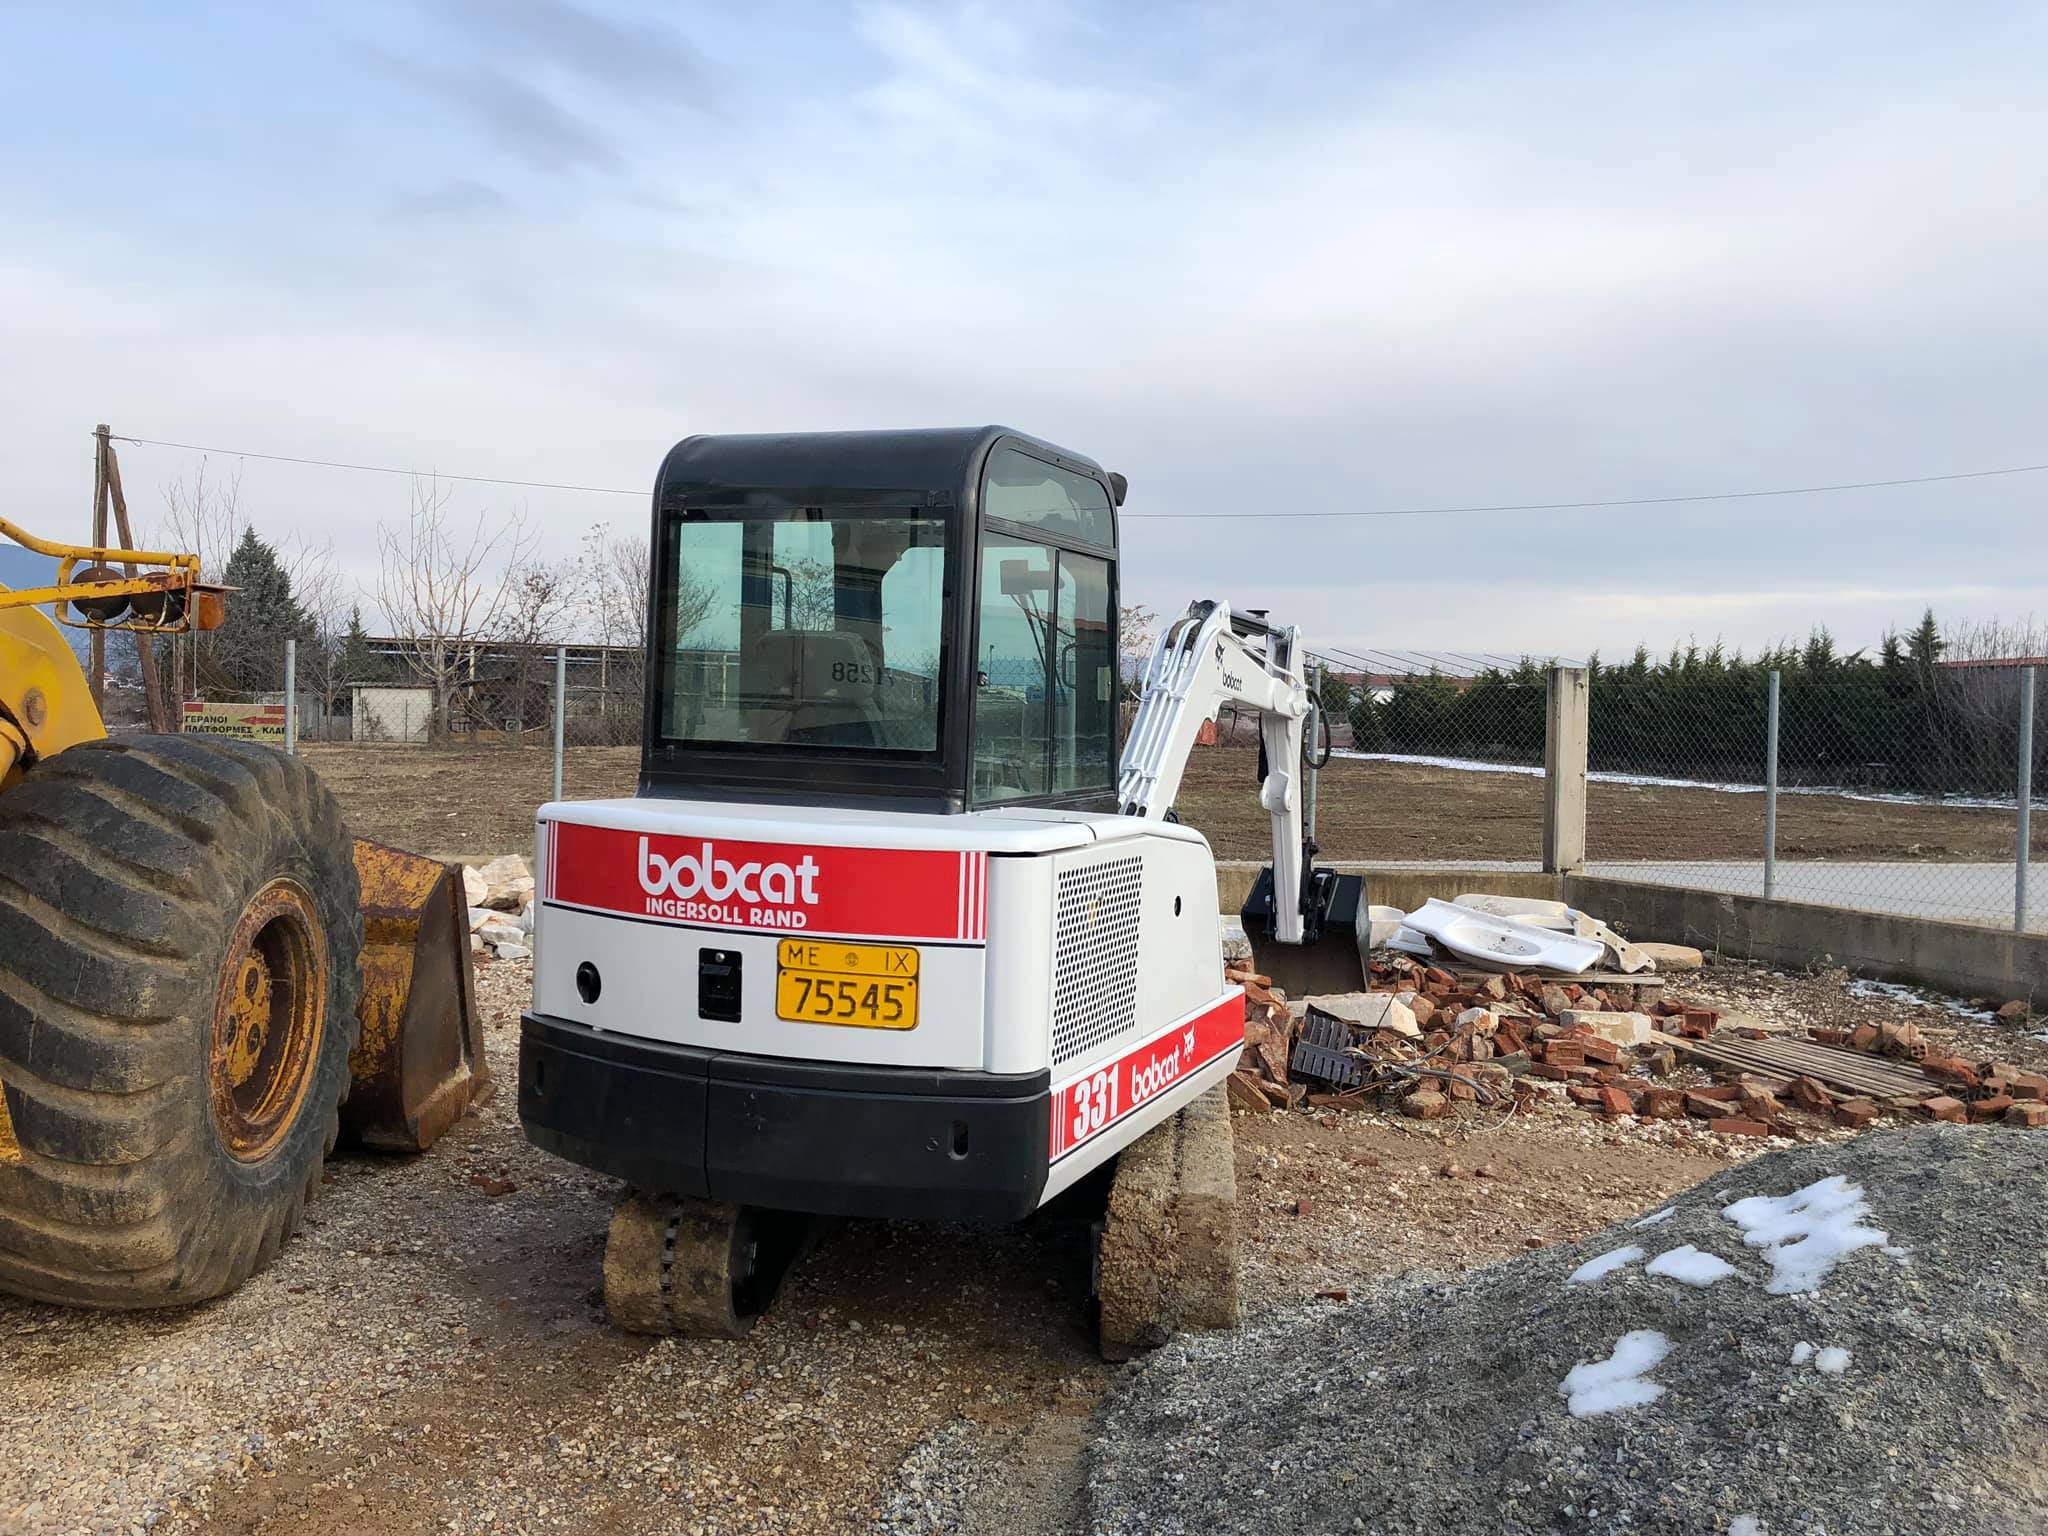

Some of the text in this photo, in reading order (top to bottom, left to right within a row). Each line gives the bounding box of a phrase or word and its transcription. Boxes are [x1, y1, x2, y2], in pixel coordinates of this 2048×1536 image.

[1222, 667, 1242, 692] bobcat
[184, 715, 228, 724] ΓΕΡΑΝΟΙ
[184, 725, 253, 735] ΠΛΑΤΦΟΡΜΕΣ
[638, 836, 820, 905] bobcat
[646, 897, 807, 928] INGERSOLL RAND
[794, 977, 905, 1021] 75545
[1073, 1044, 1180, 1141] 331 bobcat
